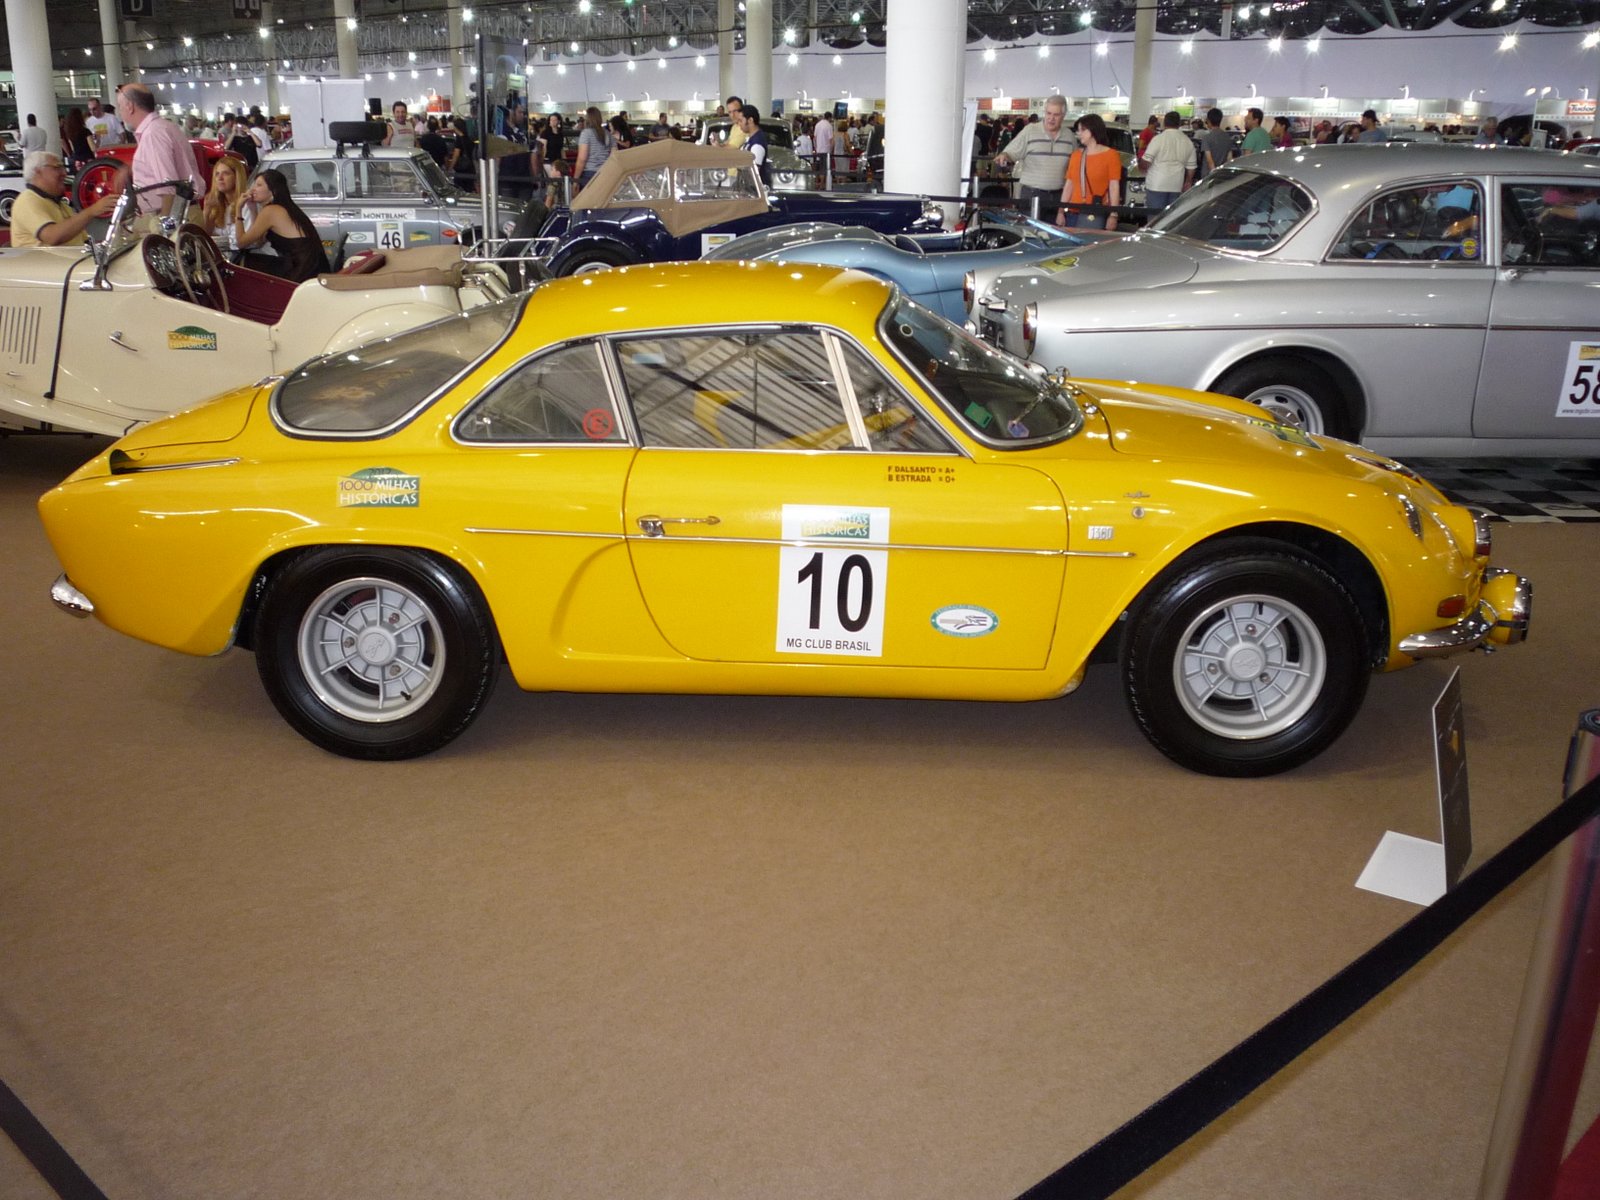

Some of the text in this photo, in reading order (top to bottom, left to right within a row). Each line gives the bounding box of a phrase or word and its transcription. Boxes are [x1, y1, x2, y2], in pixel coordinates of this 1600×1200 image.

[363, 212, 408, 220] MONTBLANC
[381, 231, 402, 249] 46
[339, 478, 417, 491] 1000 MILHAS
[895, 474, 932, 482] ESTRADA
[340, 493, 417, 505] HISTORICAS
[797, 551, 874, 633] 10
[786, 638, 872, 652] MG CLUB BRASIL
